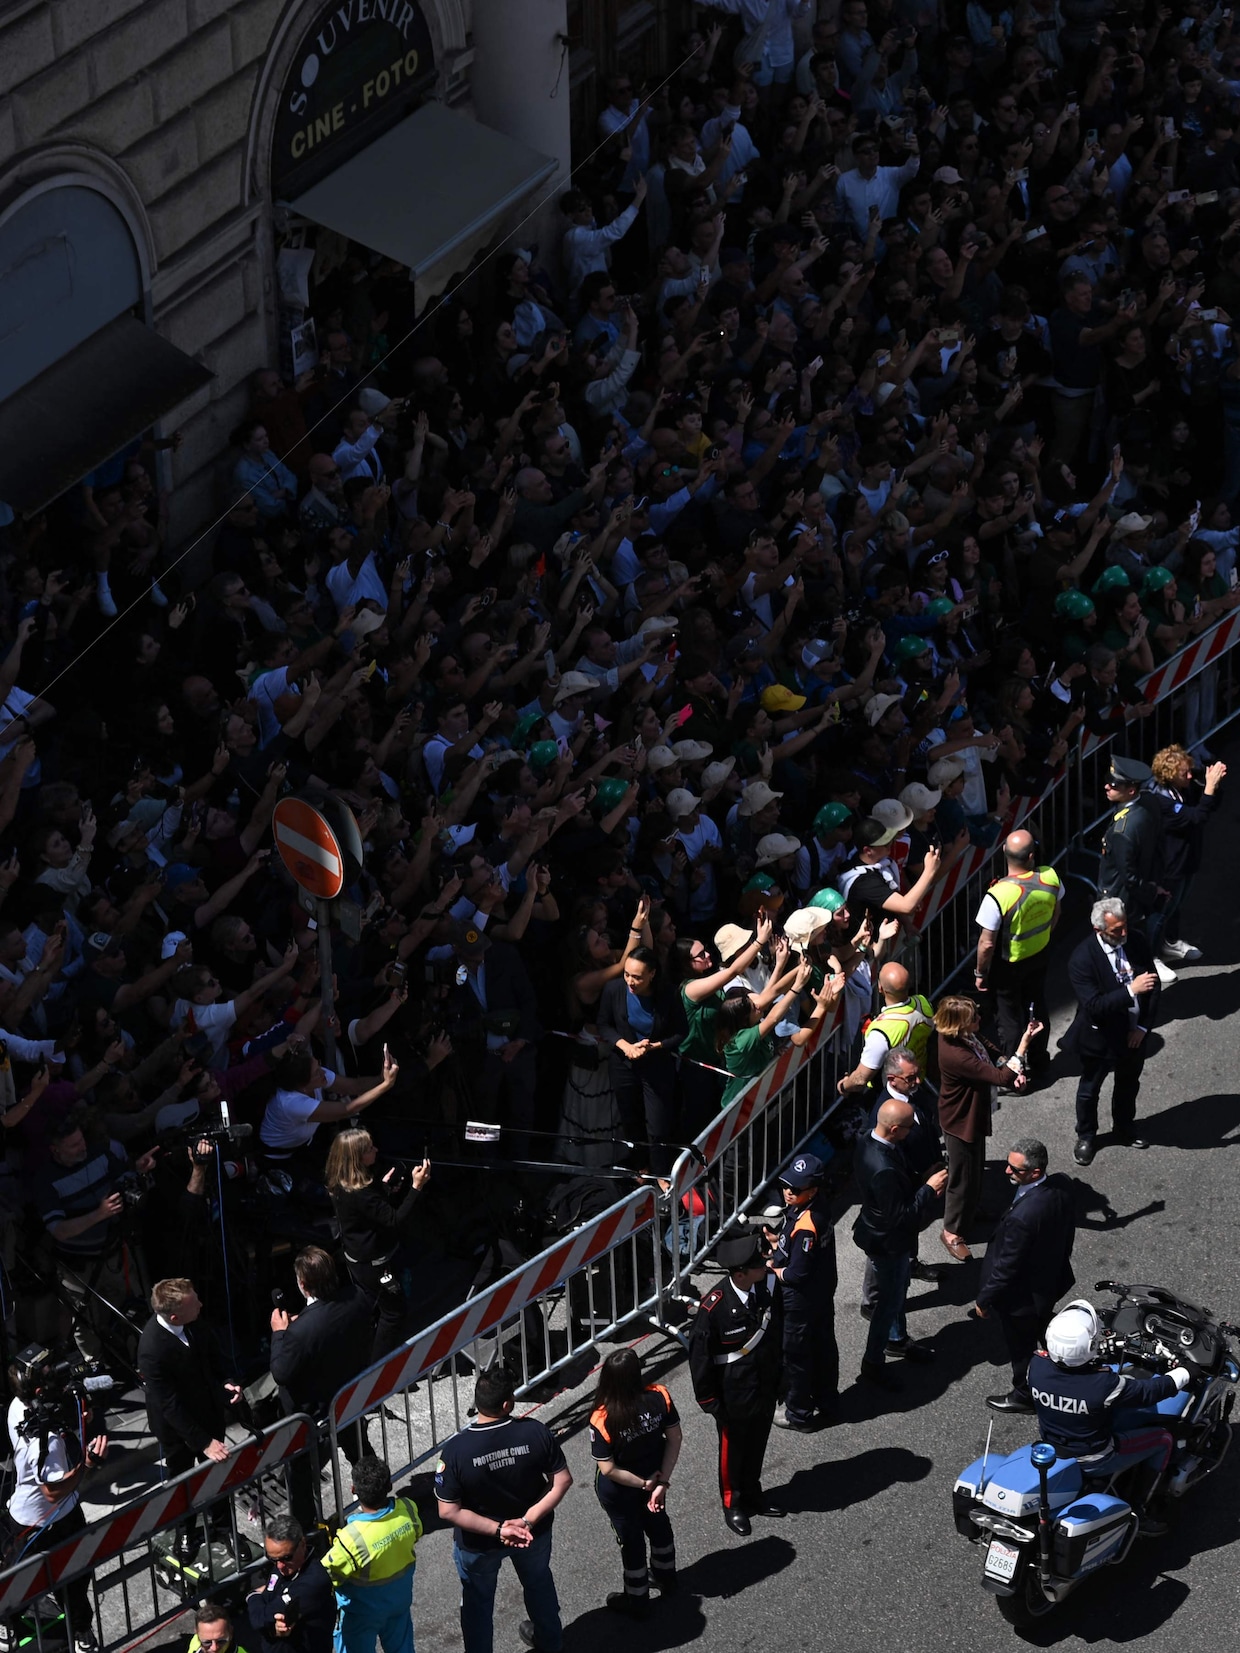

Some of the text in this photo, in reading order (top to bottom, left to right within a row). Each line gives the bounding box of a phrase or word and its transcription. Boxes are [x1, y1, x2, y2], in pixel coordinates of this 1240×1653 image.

[290, 101, 346, 159] CINE
[362, 49, 419, 109] FOTO
[1031, 1386, 1090, 1415] POLIZIA
[472, 1444, 531, 1467] PROTEZIONE CIVILE
[488, 1456, 516, 1471] VELLETRI
[990, 1544, 1017, 1559] POLIZIA
[988, 1554, 1015, 1573] G2685
